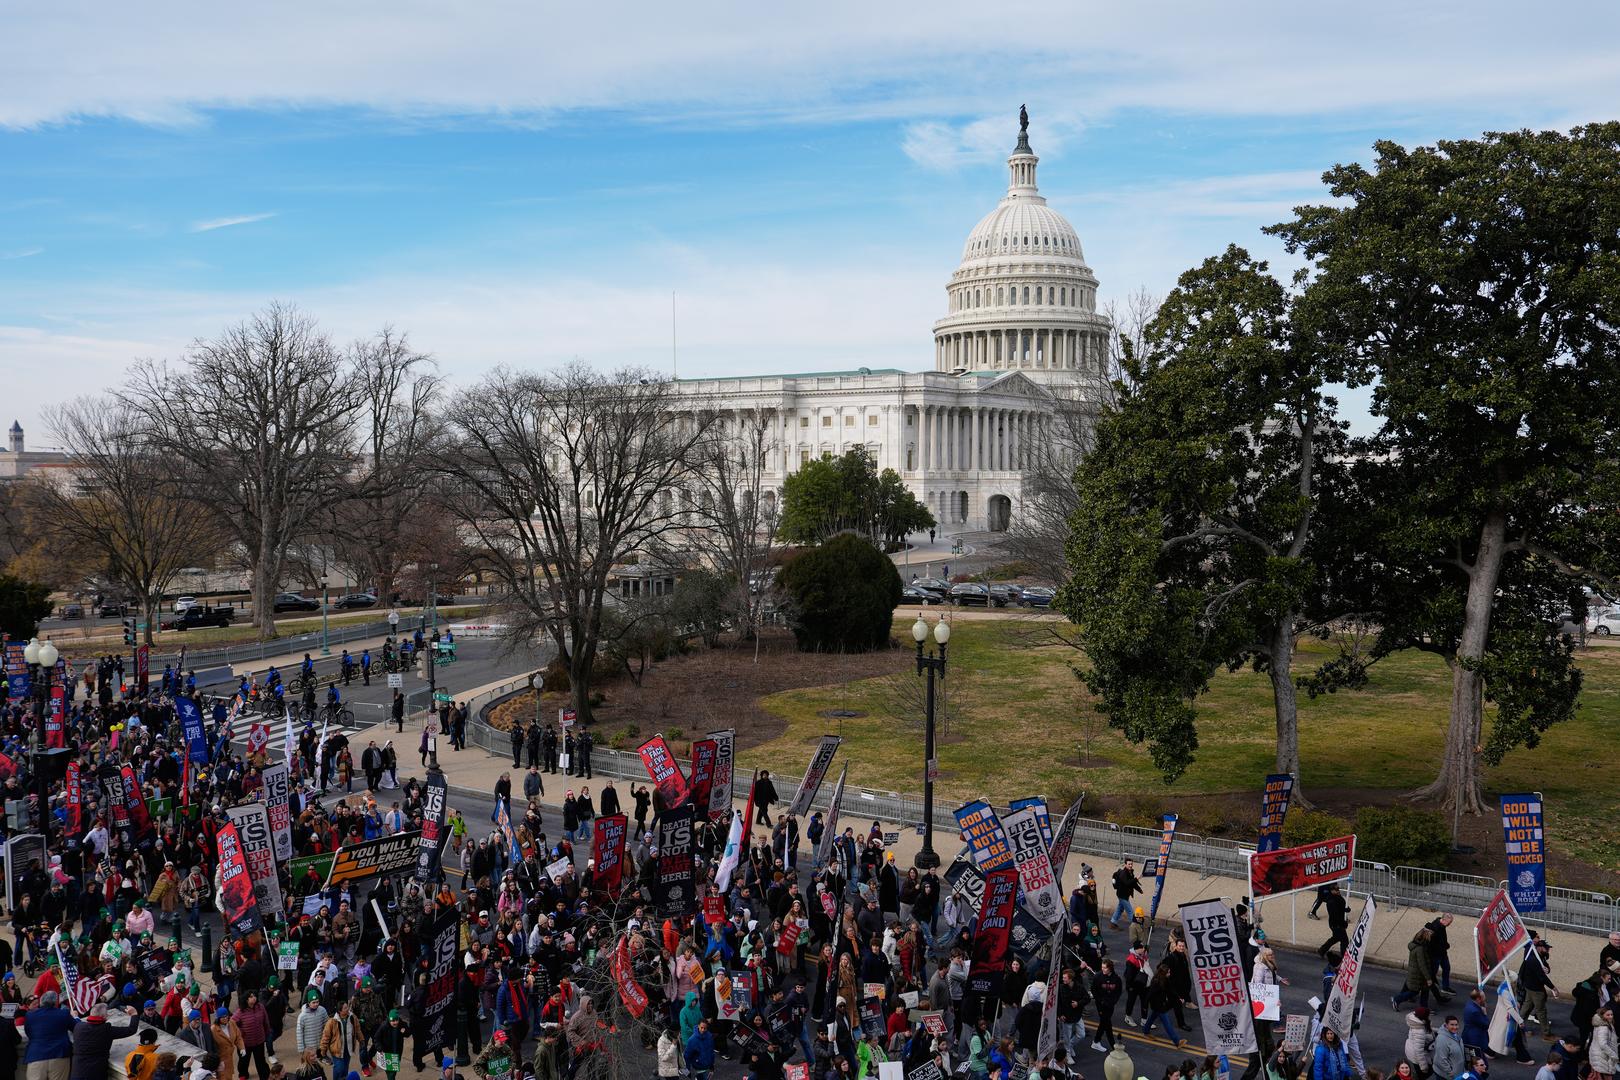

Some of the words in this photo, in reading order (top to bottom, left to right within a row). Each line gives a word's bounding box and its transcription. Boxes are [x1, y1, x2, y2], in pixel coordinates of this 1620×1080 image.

[186, 726, 200, 734] PRO
[649, 746, 665, 758] FACE
[817, 750, 832, 764] IS
[654, 755, 668, 765] EVIL
[654, 764, 666, 774] WE
[656, 767, 676, 782] STAND
[266, 772, 285, 784] LIFE
[104, 783, 124, 798] IS
[268, 780, 287, 800] IS
[427, 786, 444, 796] DEATH
[1266, 782, 1283, 792] GOD
[425, 793, 444, 813] IS
[1268, 792, 1288, 802] WILL
[269, 805, 288, 815] REV
[1504, 803, 1528, 814] GOD
[231, 812, 264, 827] LIFE
[424, 811, 441, 822] NOT
[959, 812, 982, 828] GOD
[1269, 814, 1282, 824] BE
[1510, 815, 1540, 828] WILL
[606, 825, 624, 839] FACE
[662, 818, 691, 831] DEATH
[968, 818, 998, 838] WILL
[1008, 818, 1035, 836] LIFE
[237, 823, 267, 844] IS
[662, 826, 691, 848] IS
[972, 832, 996, 850] NOT
[1011, 828, 1040, 854] IS
[1510, 829, 1533, 840] NOT
[222, 834, 236, 850] FACE
[245, 840, 269, 852] UR
[419, 838, 438, 849] HERE!
[608, 838, 620, 849] EVIL
[988, 841, 1006, 856] BE
[1522, 842, 1540, 852] BE
[224, 845, 238, 860] EVIL
[248, 849, 271, 862] EVO
[351, 846, 377, 860] YOU
[380, 840, 408, 854] WILL
[602, 849, 614, 860] WE
[661, 843, 691, 858] NOT
[1016, 846, 1045, 864] OUR
[1313, 846, 1328, 859] FACE
[224, 858, 233, 870] WE
[250, 859, 272, 871] UT
[357, 848, 408, 868] SILENCE
[376, 856, 418, 872] MESSA
[662, 855, 690, 866] WEL
[980, 851, 1012, 872] MOCKED
[1020, 854, 1048, 872] REVO
[1508, 854, 1543, 864] MOCKED
[224, 865, 243, 882] STAND
[1022, 865, 1050, 882] LUT
[1305, 862, 1317, 876] WE
[1320, 856, 1347, 876] STAND
[252, 868, 275, 881] ON!
[660, 871, 691, 884] HERE!
[953, 868, 974, 892] DEATH
[960, 876, 986, 903] IS
[994, 882, 1013, 894] FACE
[1025, 874, 1054, 893] ION!
[972, 894, 985, 914] NO
[992, 895, 1008, 906] EVIL
[986, 906, 998, 918] WE
[982, 917, 1006, 930] STAND
[1186, 914, 1228, 932] LIFE
[1190, 928, 1234, 956] IS
[432, 934, 456, 972] IS
[1194, 951, 1238, 968] OUR
[430, 957, 456, 984] NOT
[1197, 964, 1241, 980] REVO
[1200, 977, 1242, 994] LUT
[1202, 990, 1246, 1008] ION!
[488, 1060, 499, 1070] LOVE
[500, 1057, 508, 1066] LIFE
